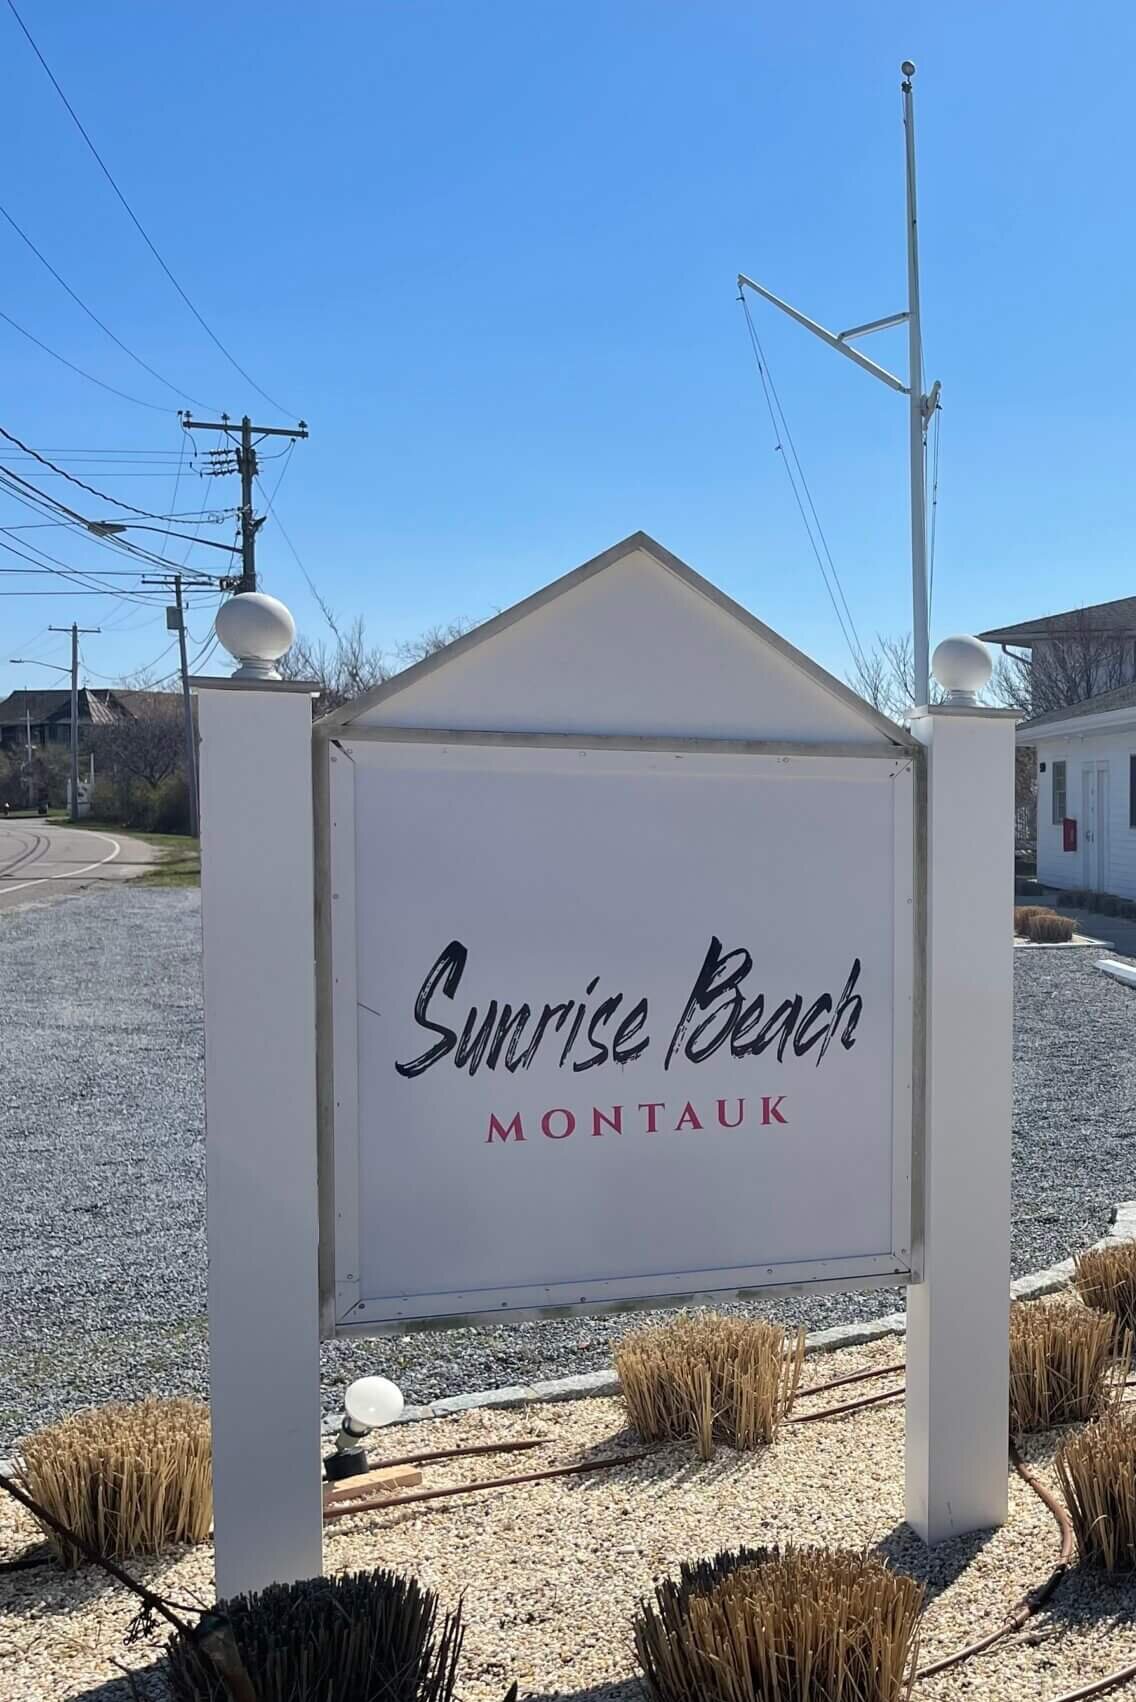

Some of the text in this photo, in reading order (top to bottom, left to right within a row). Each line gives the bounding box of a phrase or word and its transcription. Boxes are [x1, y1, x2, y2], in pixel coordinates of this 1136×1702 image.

[395, 935, 863, 1079] Sunrise Beach
[485, 1095, 790, 1143] MONTAUK
